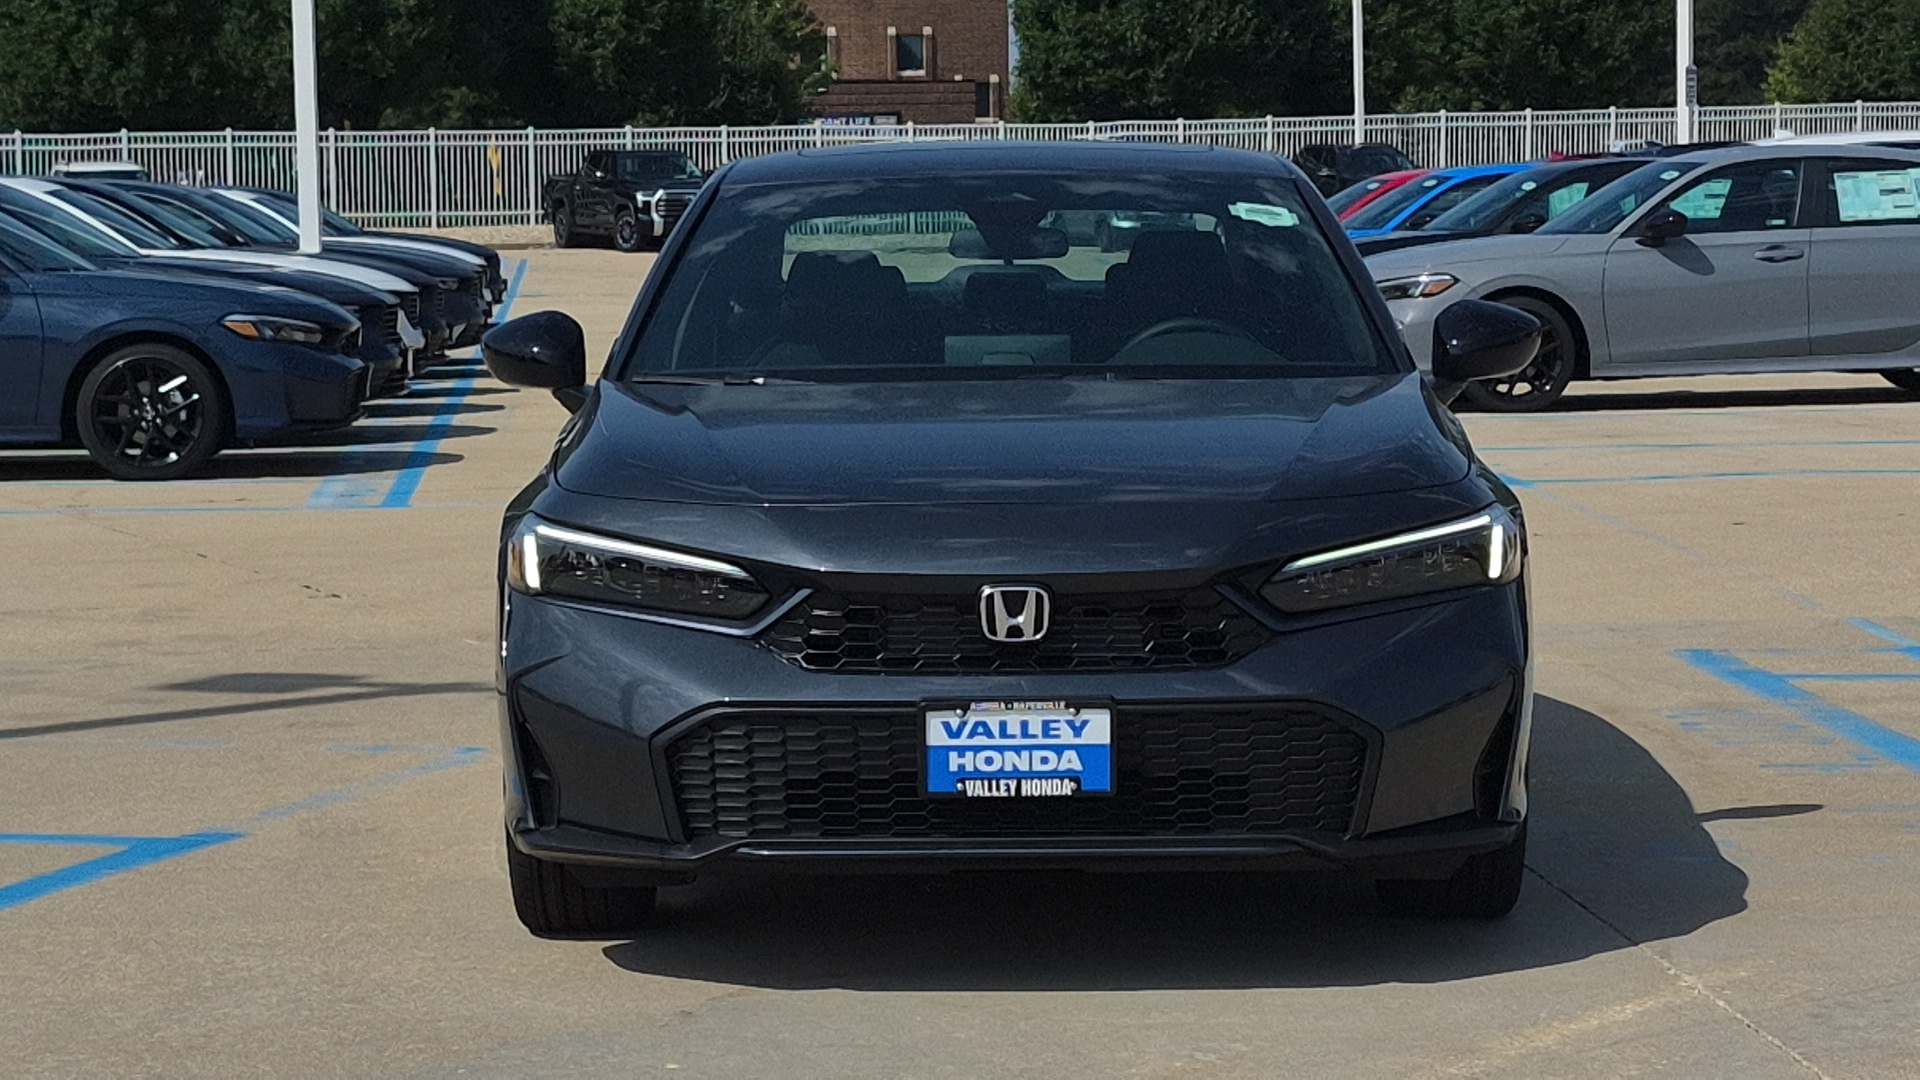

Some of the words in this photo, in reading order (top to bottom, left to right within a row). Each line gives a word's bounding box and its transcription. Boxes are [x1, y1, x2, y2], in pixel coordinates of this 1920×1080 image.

[940, 719, 1091, 740] VALLEY
[949, 750, 1083, 772] HONDA
[965, 779, 1016, 797] VALLEY
[1021, 778, 1072, 796] HONDA
